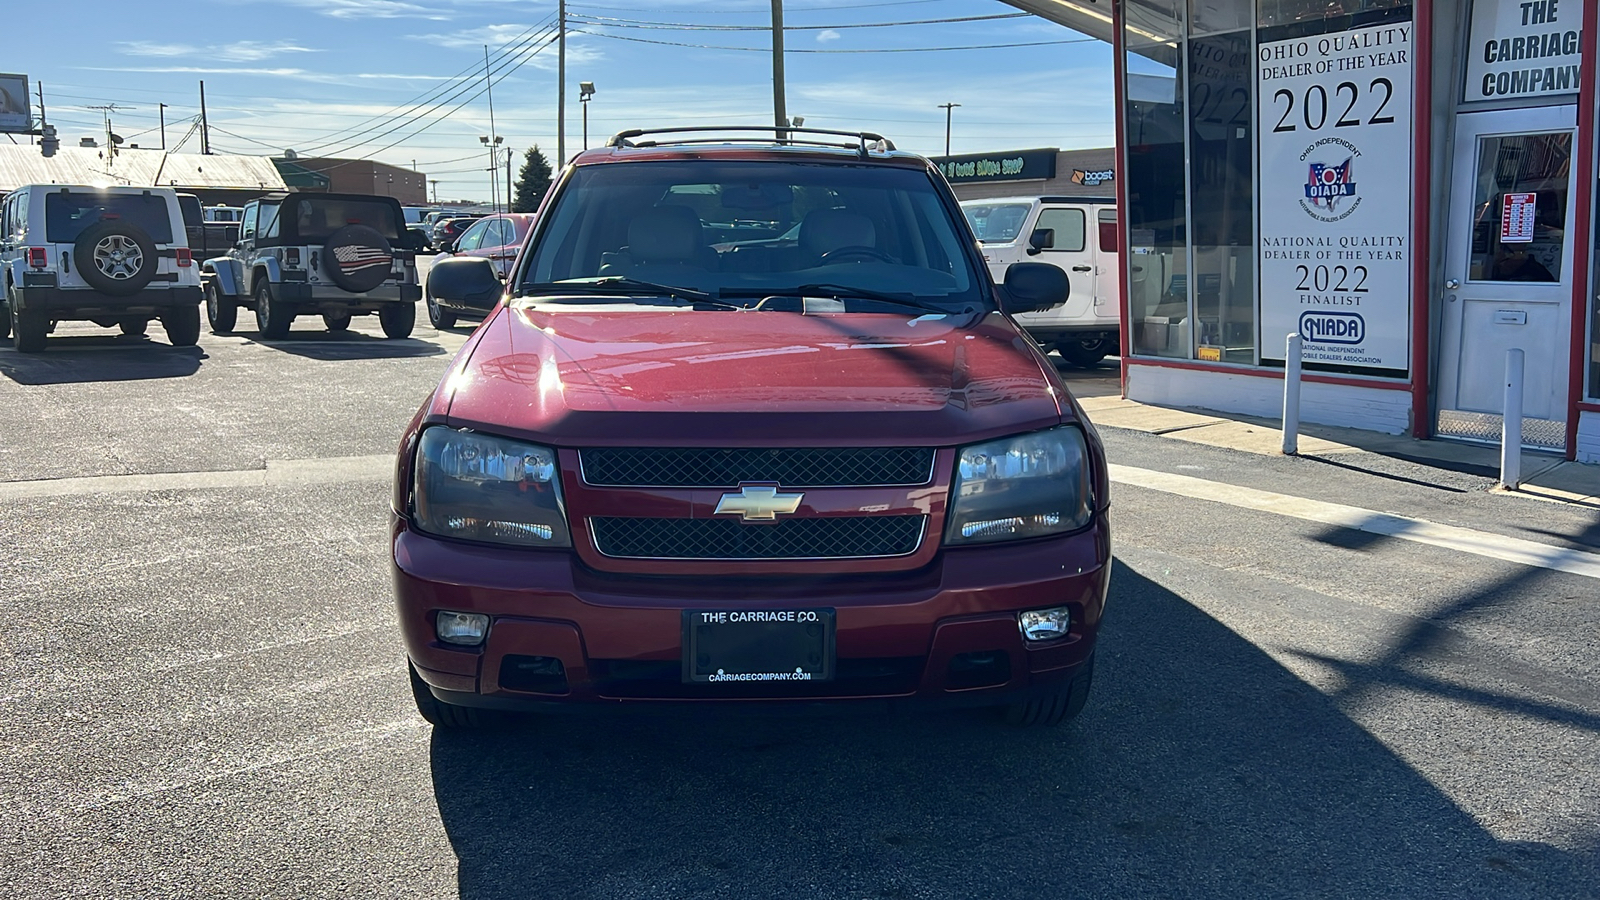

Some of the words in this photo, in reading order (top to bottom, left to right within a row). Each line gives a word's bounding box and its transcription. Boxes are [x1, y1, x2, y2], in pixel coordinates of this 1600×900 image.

[1520, 1, 1558, 26] THE
[1260, 42, 1308, 62] OHIO
[1318, 27, 1410, 56] QUALITY
[1262, 62, 1312, 81] DEALER
[1316, 60, 1334, 74] OF
[1337, 56, 1365, 71] THE
[1369, 50, 1408, 67] YEAR
[1482, 65, 1582, 97] COMPANY
[1273, 77, 1395, 133] 2022
[1299, 144, 1315, 162] OHIO
[1315, 137, 1363, 158] INDEPENDENT
[1002, 156, 1024, 175] SHOP
[1084, 169, 1113, 181] boost
[1310, 184, 1348, 197] OIADA
[1263, 237, 1333, 247] NATIONAL
[1339, 236, 1405, 248] QUALITY
[1264, 250, 1311, 260] DEALER
[1316, 250, 1332, 260] OF
[1337, 250, 1362, 260] THE
[1369, 250, 1403, 260] YEAR
[1295, 264, 1369, 293] 2022
[1300, 294, 1362, 306] FINALIST
[1304, 317, 1359, 341] NIADA
[1327, 346, 1366, 355] INDEPENDENT
[1343, 356, 1382, 364] ASSOCIATION
[702, 612, 727, 623] THE
[730, 611, 795, 622] CARRIAGE
[798, 611, 819, 622] CO.
[708, 672, 811, 682] CARRIAGECOMPANY.COM
